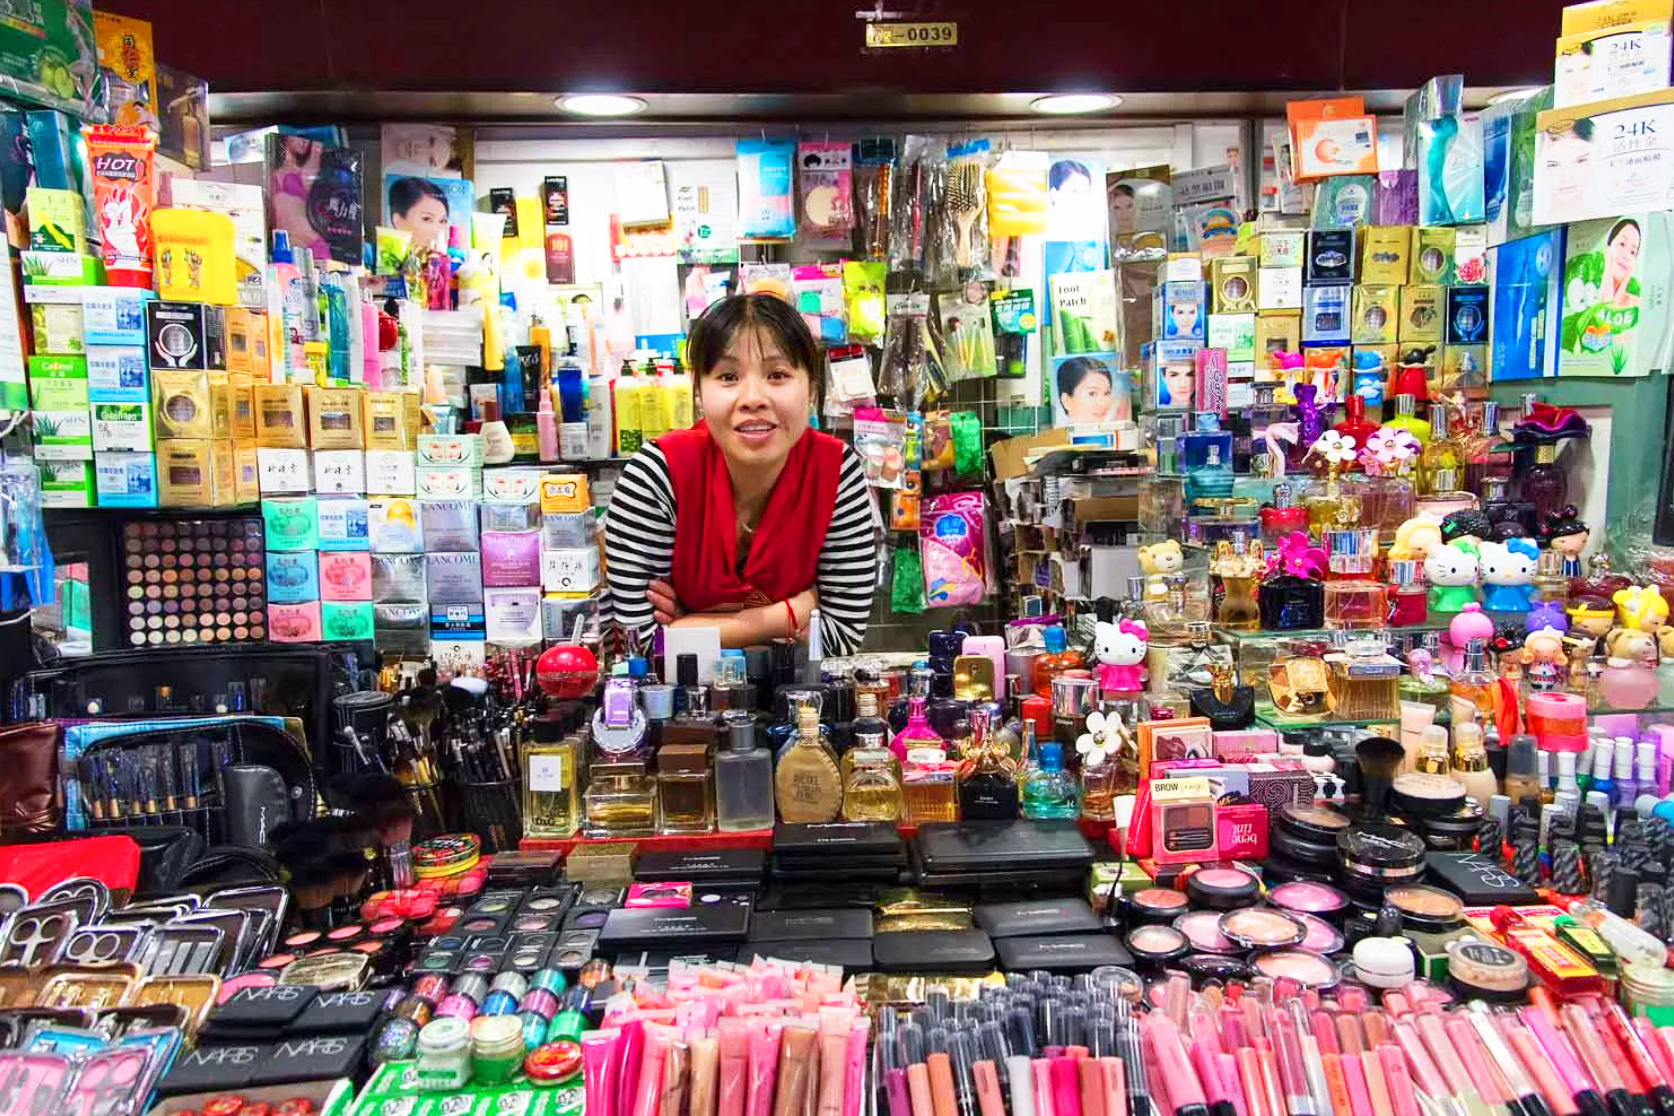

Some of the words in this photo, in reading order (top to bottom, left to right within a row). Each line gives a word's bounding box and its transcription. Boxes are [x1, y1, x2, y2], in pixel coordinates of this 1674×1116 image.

[1609, 38, 1642, 54] 24K
[1613, 119, 1656, 140] 24K
[96, 157, 135, 172] HOT
[551, 238, 569, 252] 101
[1059, 297, 1087, 308] Patch
[1597, 309, 1634, 325] ALOE
[1154, 782, 1179, 793] BROW
[258, 805, 267, 845] MAC
[1232, 823, 1253, 835] tint
[1231, 833, 1258, 846] bene
[1445, 853, 1520, 888] NARS
[235, 986, 304, 1001] NARS
[310, 990, 376, 1009] NARS
[273, 1037, 348, 1059] NARS
[183, 1046, 259, 1067] NARS
